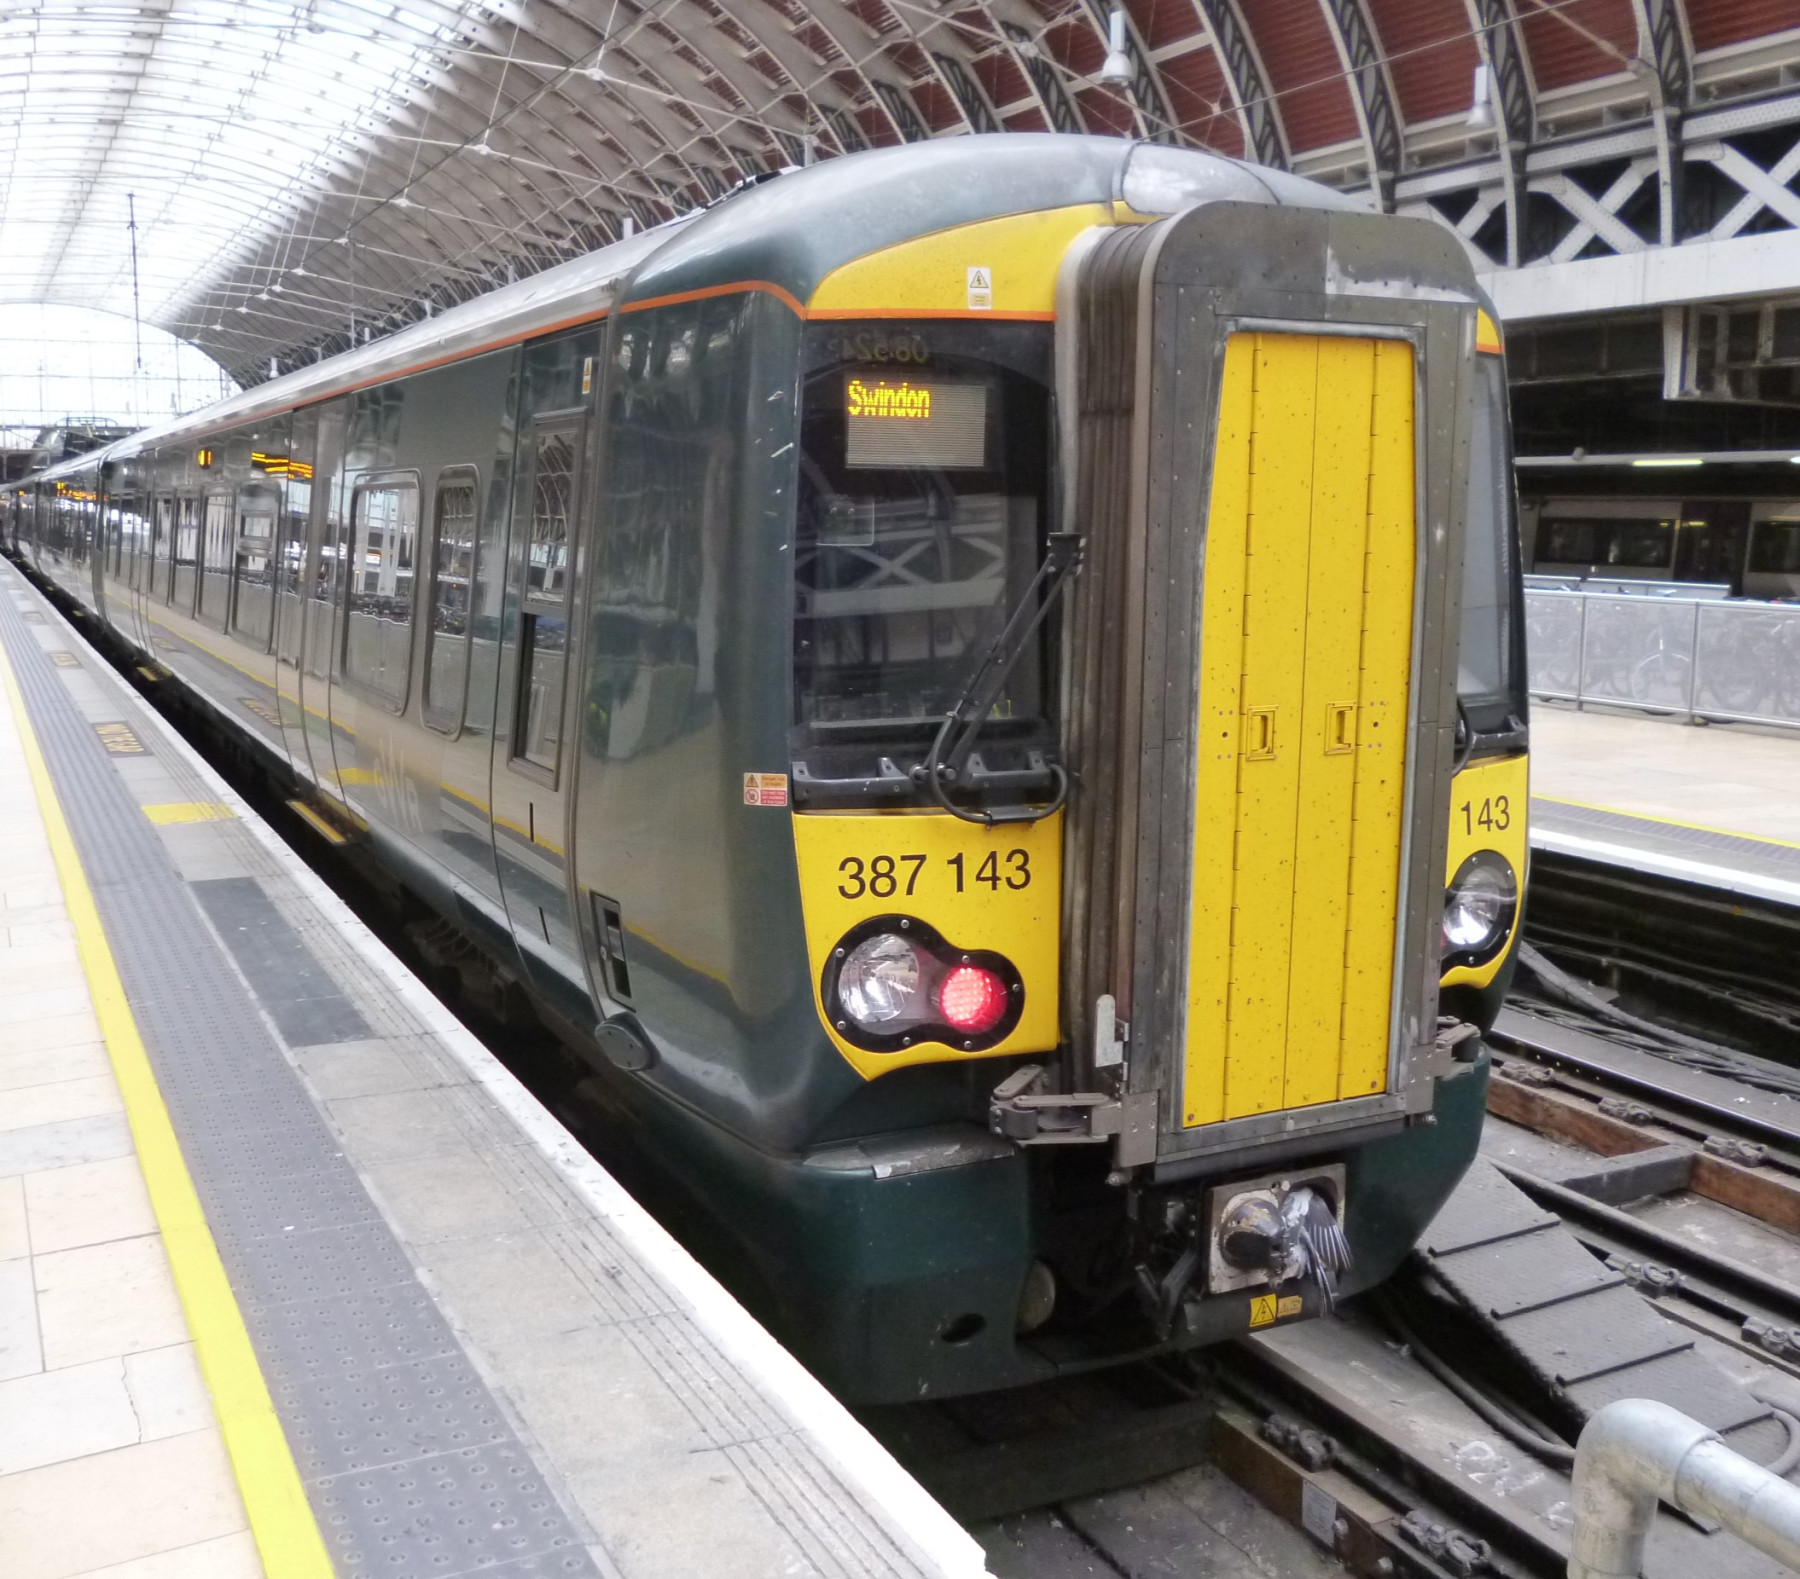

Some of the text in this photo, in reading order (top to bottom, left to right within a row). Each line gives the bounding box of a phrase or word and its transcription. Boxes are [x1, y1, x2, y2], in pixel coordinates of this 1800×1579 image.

[847, 380, 931, 418] Swindon
[373, 731, 424, 833] GWR
[1461, 795, 1510, 836] 143
[837, 848, 1032, 899] 387 143
